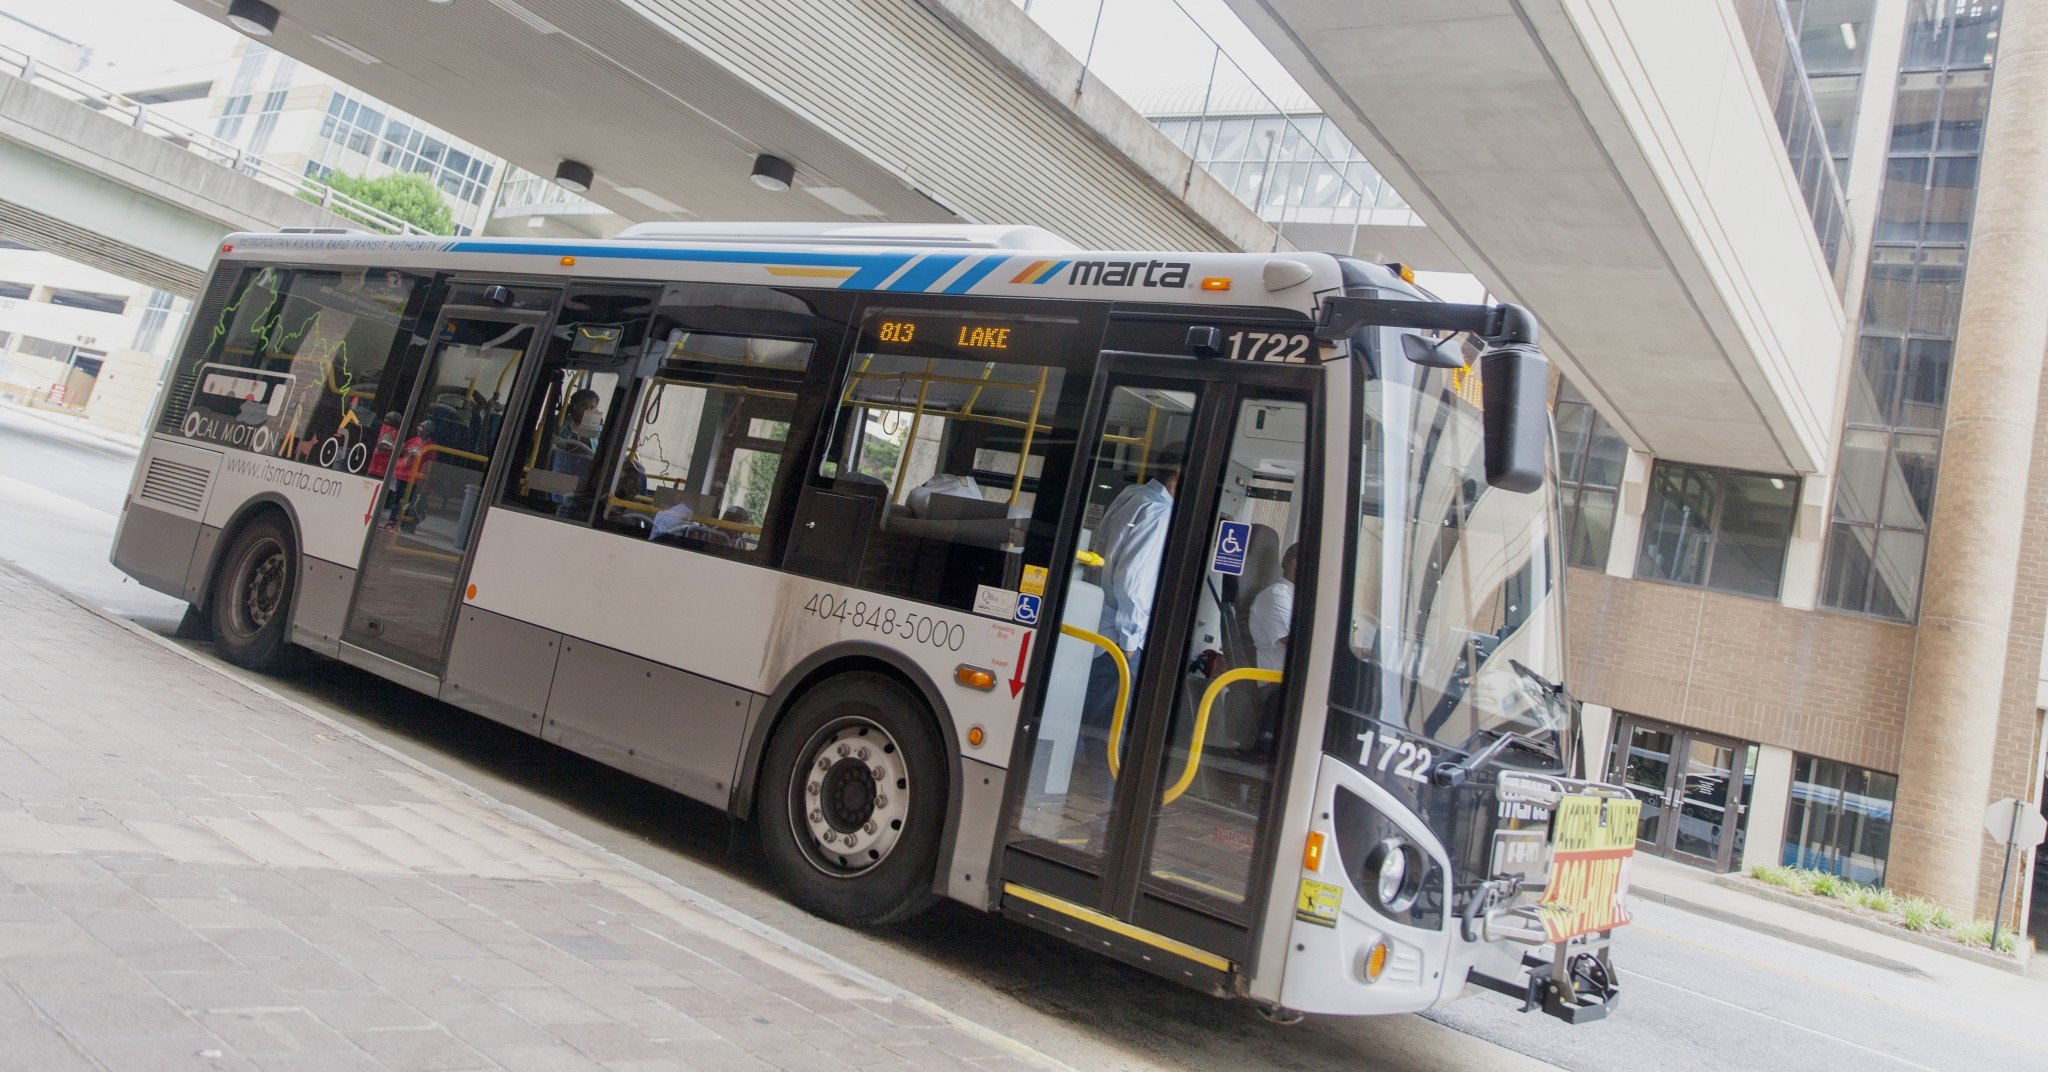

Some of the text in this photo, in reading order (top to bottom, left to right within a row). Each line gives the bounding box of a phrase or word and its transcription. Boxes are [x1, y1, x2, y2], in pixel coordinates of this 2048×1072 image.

[326, 239, 350, 250] RAPID
[351, 239, 386, 251] TRANSIT
[387, 240, 438, 251] AUTHORITY
[1068, 259, 1190, 288] marta
[879, 322, 1011, 348] 813 LAKE
[1228, 331, 1310, 364] 1722
[180, 411, 279, 453] LOCAL MOTION
[227, 455, 343, 498] www.itsmarta.com
[805, 593, 965, 651] 404-848-5000
[991, 658, 1009, 668] RAMP
[1357, 730, 1432, 783] 1722
